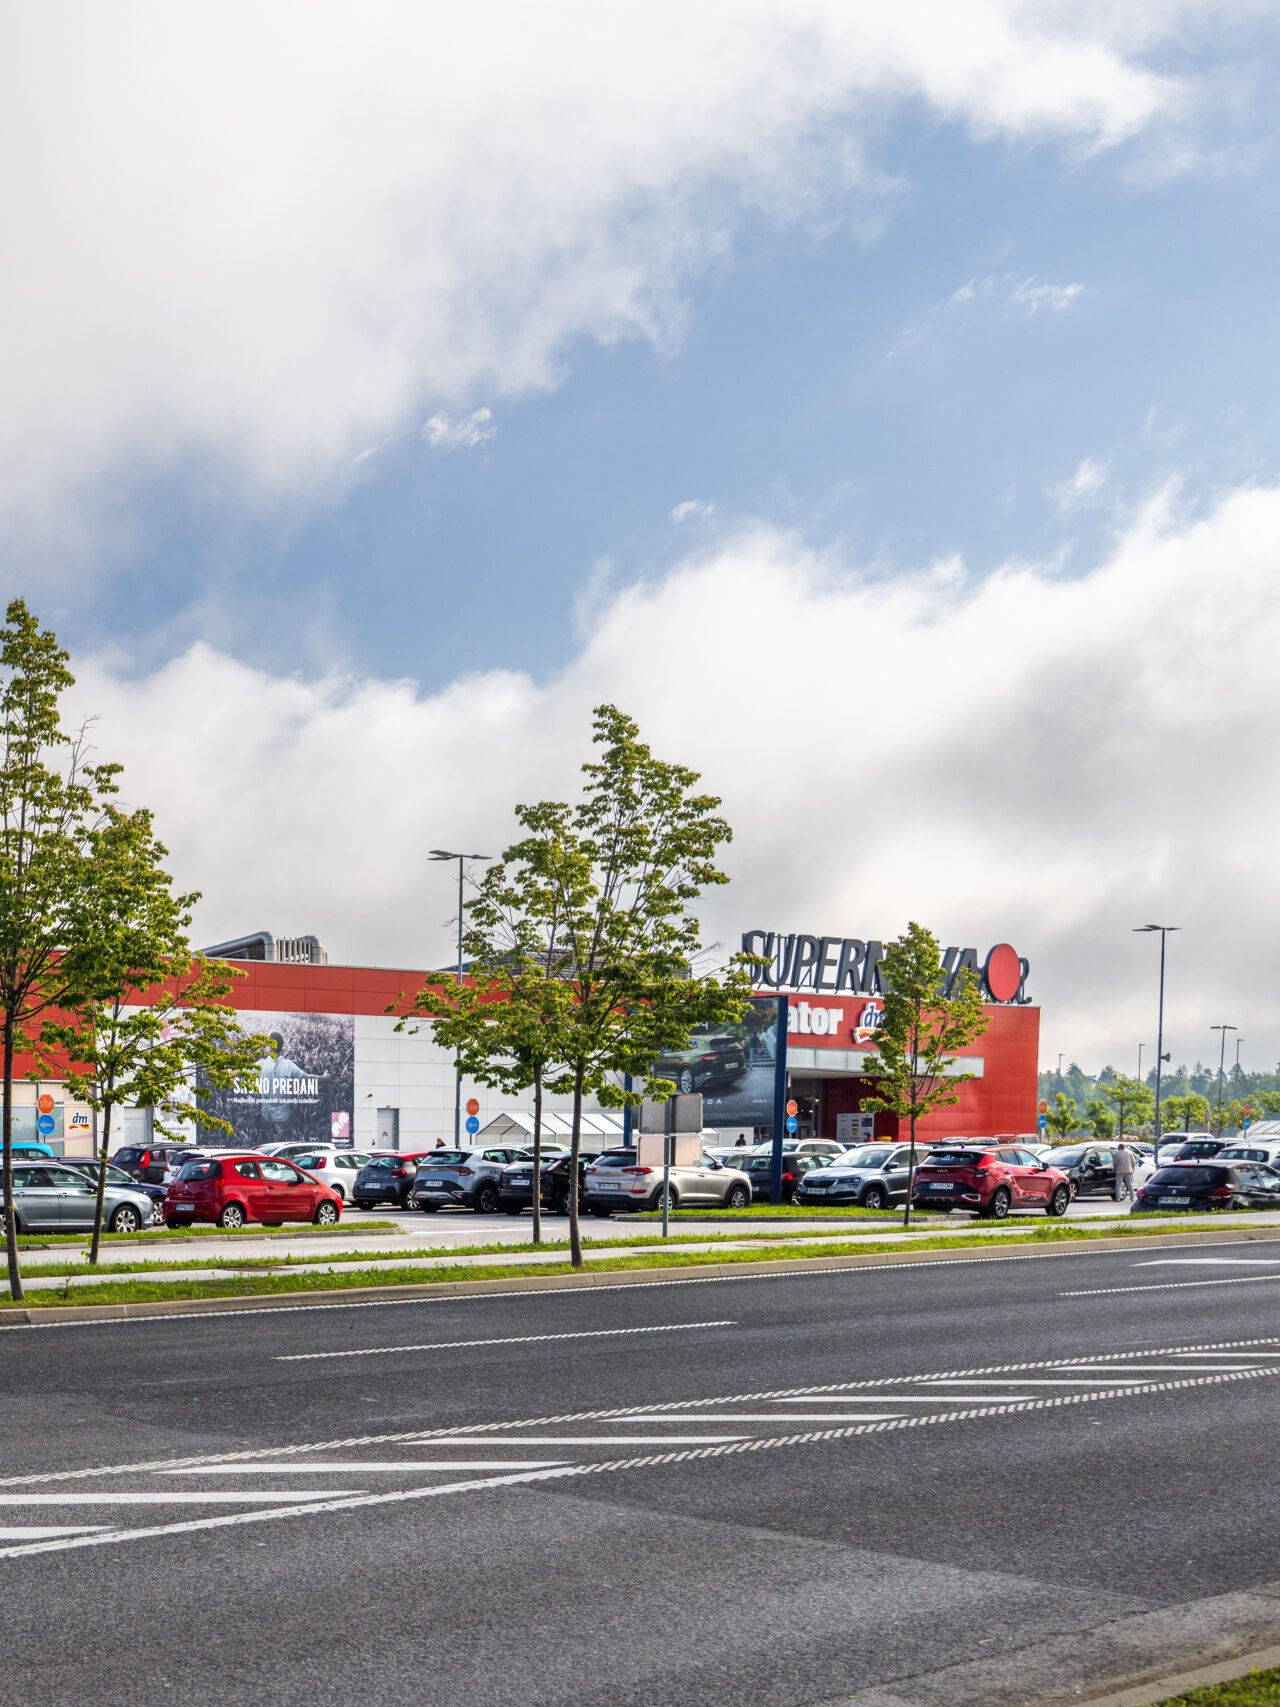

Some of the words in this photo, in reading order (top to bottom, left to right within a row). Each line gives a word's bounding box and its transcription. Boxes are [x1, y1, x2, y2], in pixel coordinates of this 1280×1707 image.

[741, 930, 983, 1000] SUPERNA
[272, 1078, 318, 1095] PREDANI
[72, 1112, 88, 1124] dm
